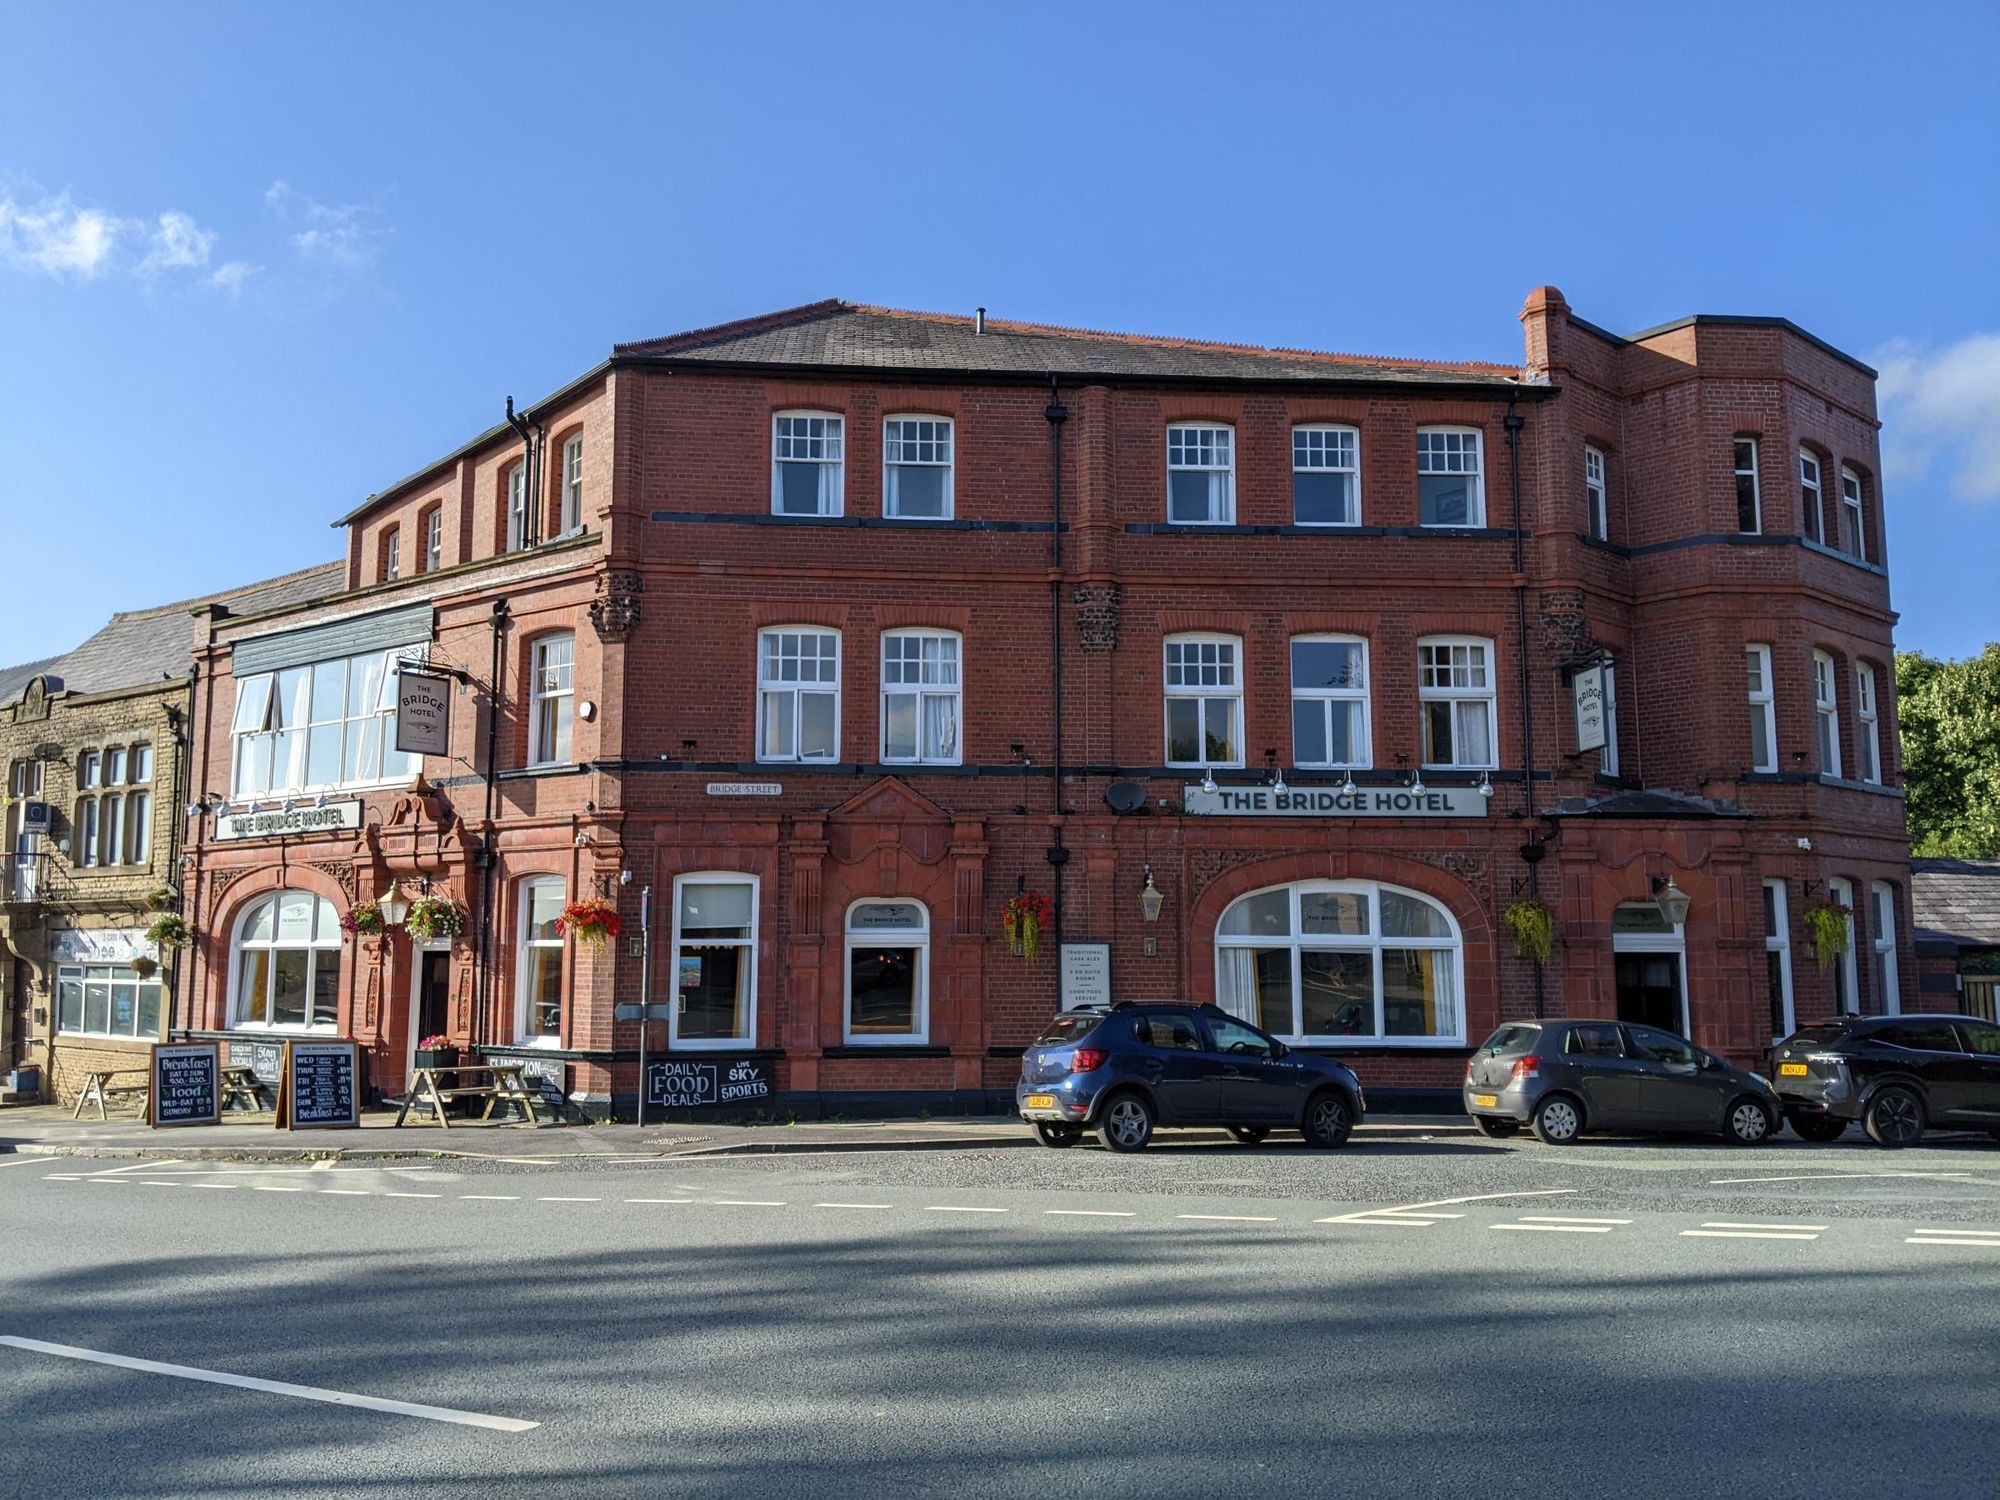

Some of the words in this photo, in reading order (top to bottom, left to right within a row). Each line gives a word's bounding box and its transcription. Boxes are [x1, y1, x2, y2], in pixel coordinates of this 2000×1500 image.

[1584, 678, 1593, 686] THE
[416, 685, 432, 693] THE
[402, 694, 444, 712] BRIDGE
[1578, 688, 1602, 706] BRIDGE
[410, 708, 436, 718] HOTEL
[1582, 702, 1598, 712] HOTEL
[710, 784, 742, 793] BRIDGE
[745, 784, 778, 793] STREET
[1219, 792, 1267, 810] THE
[1276, 792, 1368, 810] BRIDGE
[1376, 792, 1455, 811] HOTEL
[230, 818, 254, 832] THE
[255, 812, 300, 830] BRIDGE
[302, 809, 345, 826] HOTEL
[162, 1057, 210, 1070] Breakfast
[665, 1063, 702, 1076] DAILY
[728, 1068, 759, 1080] SKY
[654, 1076, 709, 1093] FOOD
[721, 1082, 768, 1100] SPORTS
[297, 1088, 311, 1096] SAT
[663, 1093, 701, 1106] DEALS
[163, 1107, 192, 1116] SUNDAY
[298, 1107, 332, 1120] Breakfast
